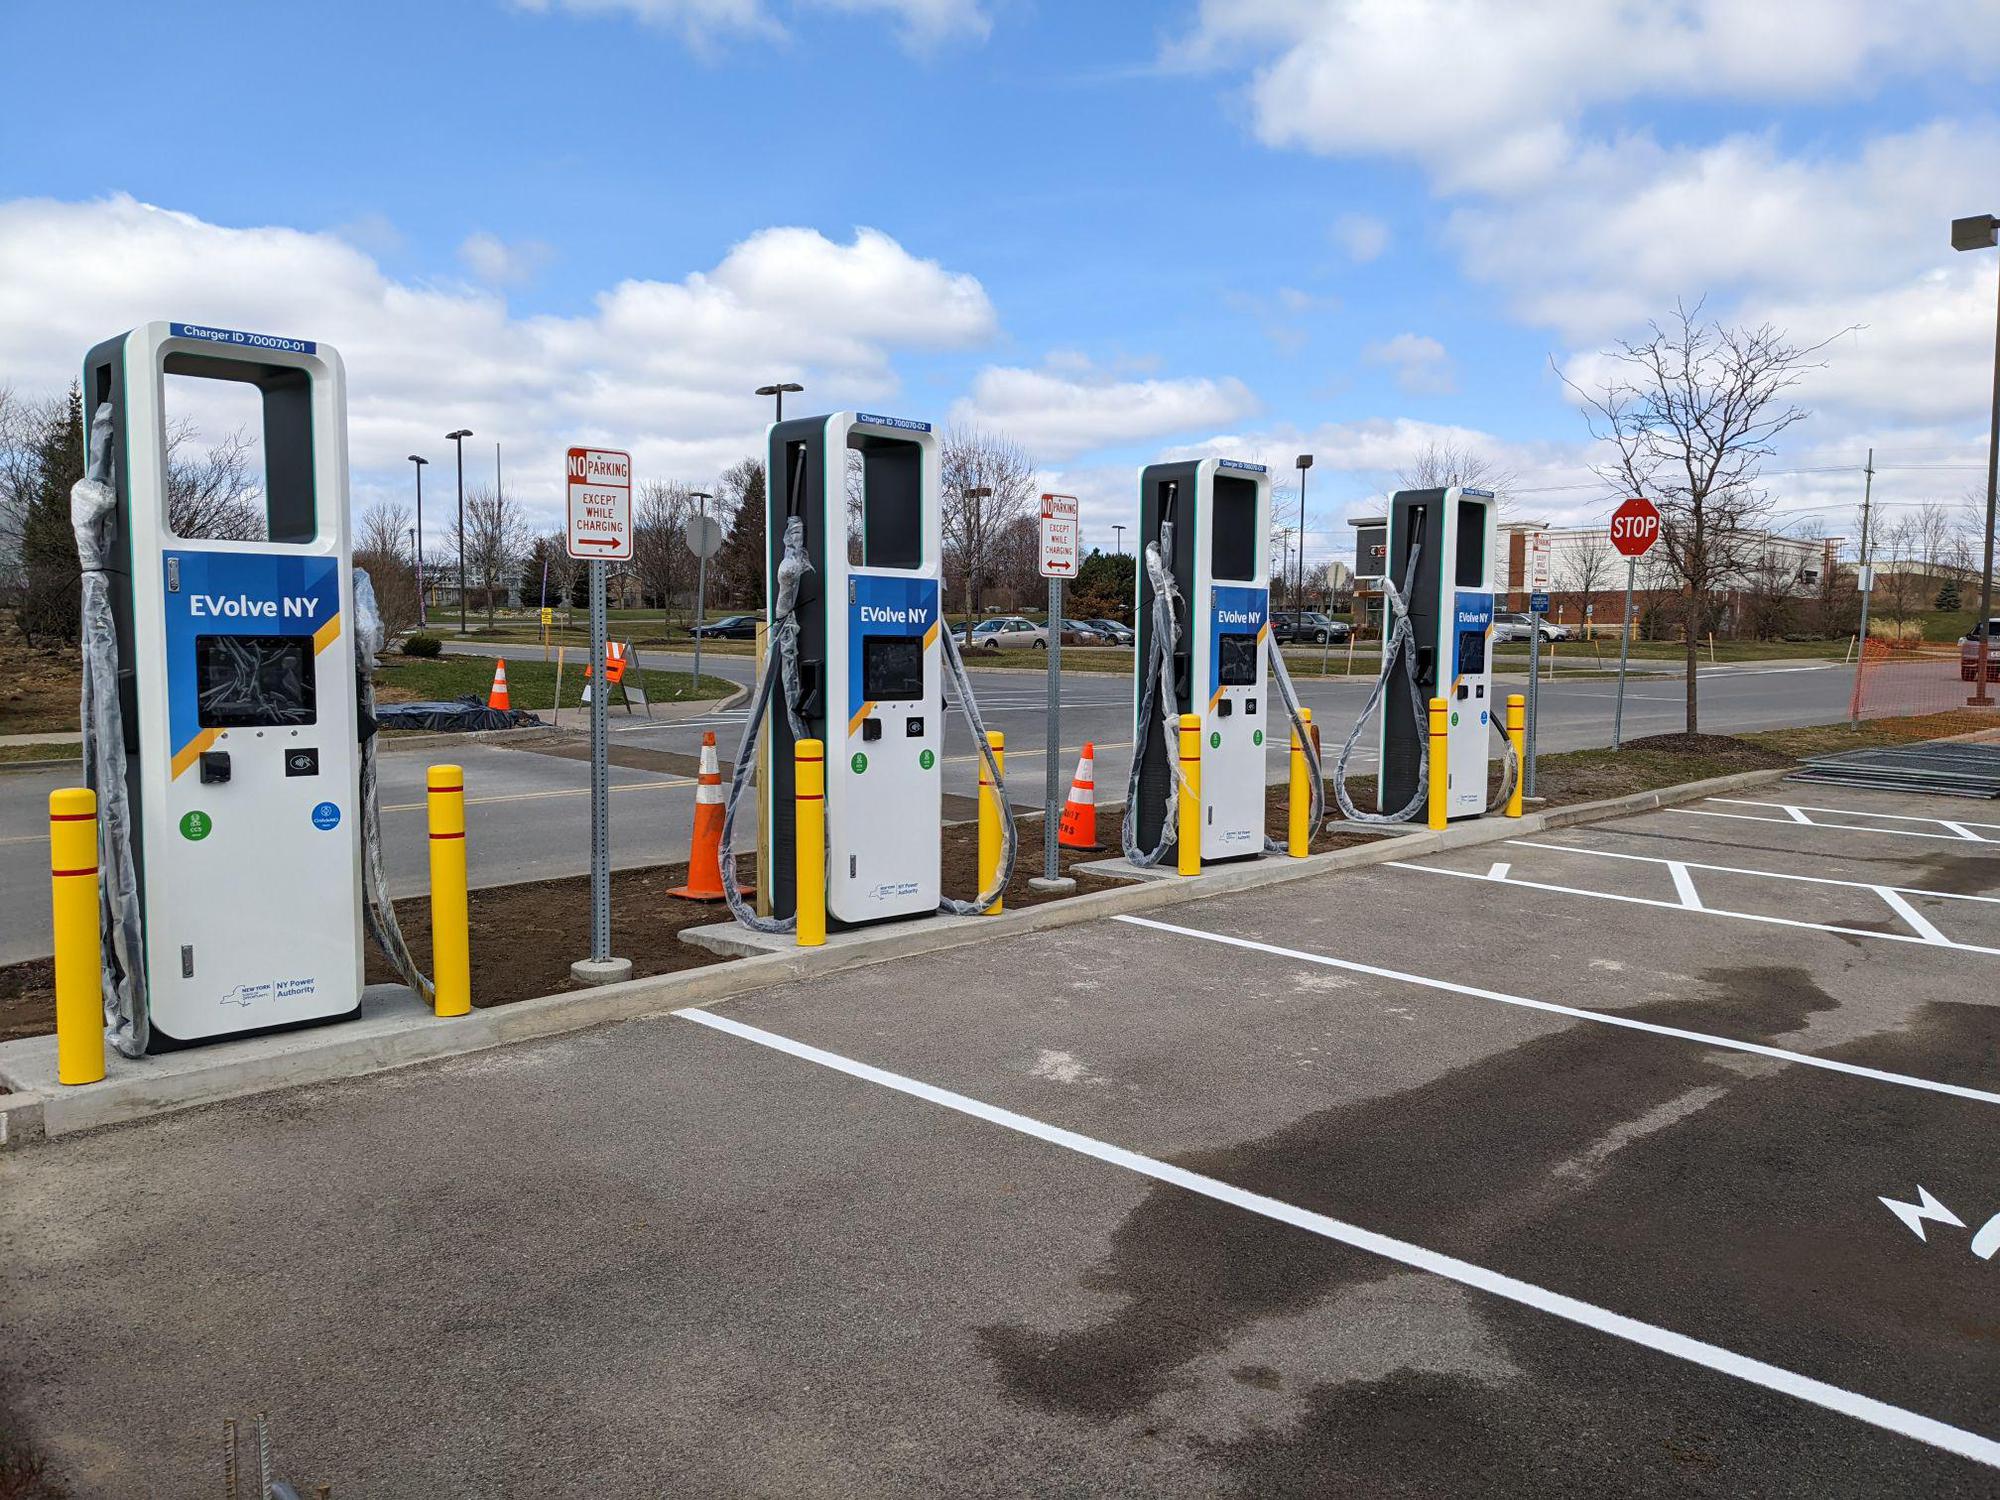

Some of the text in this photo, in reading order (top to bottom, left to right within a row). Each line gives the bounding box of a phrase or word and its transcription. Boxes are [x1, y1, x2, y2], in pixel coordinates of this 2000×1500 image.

[183, 325, 305, 351] Charger ID 700070-01
[861, 414, 885, 424] Charger
[894, 419, 926, 430] 700070-02
[568, 456, 627, 477] NO PARKING
[583, 493, 617, 506] EXCEPT
[585, 507, 614, 519] WHILE
[1043, 498, 1076, 515] NO PARKING
[577, 520, 623, 533] CHARGING
[1049, 524, 1070, 533] EXCEPT
[1613, 516, 1657, 539] STOP
[1051, 535, 1068, 544] WHILE
[1045, 545, 1073, 556] CHARGING
[190, 594, 319, 618] EVolve NY
[860, 606, 928, 624] EVolve NY
[1218, 610, 1261, 624] EVolve NY
[1480, 612, 1489, 623] NY
[276, 978, 315, 990] NY Power
[277, 985, 315, 998] Authority
